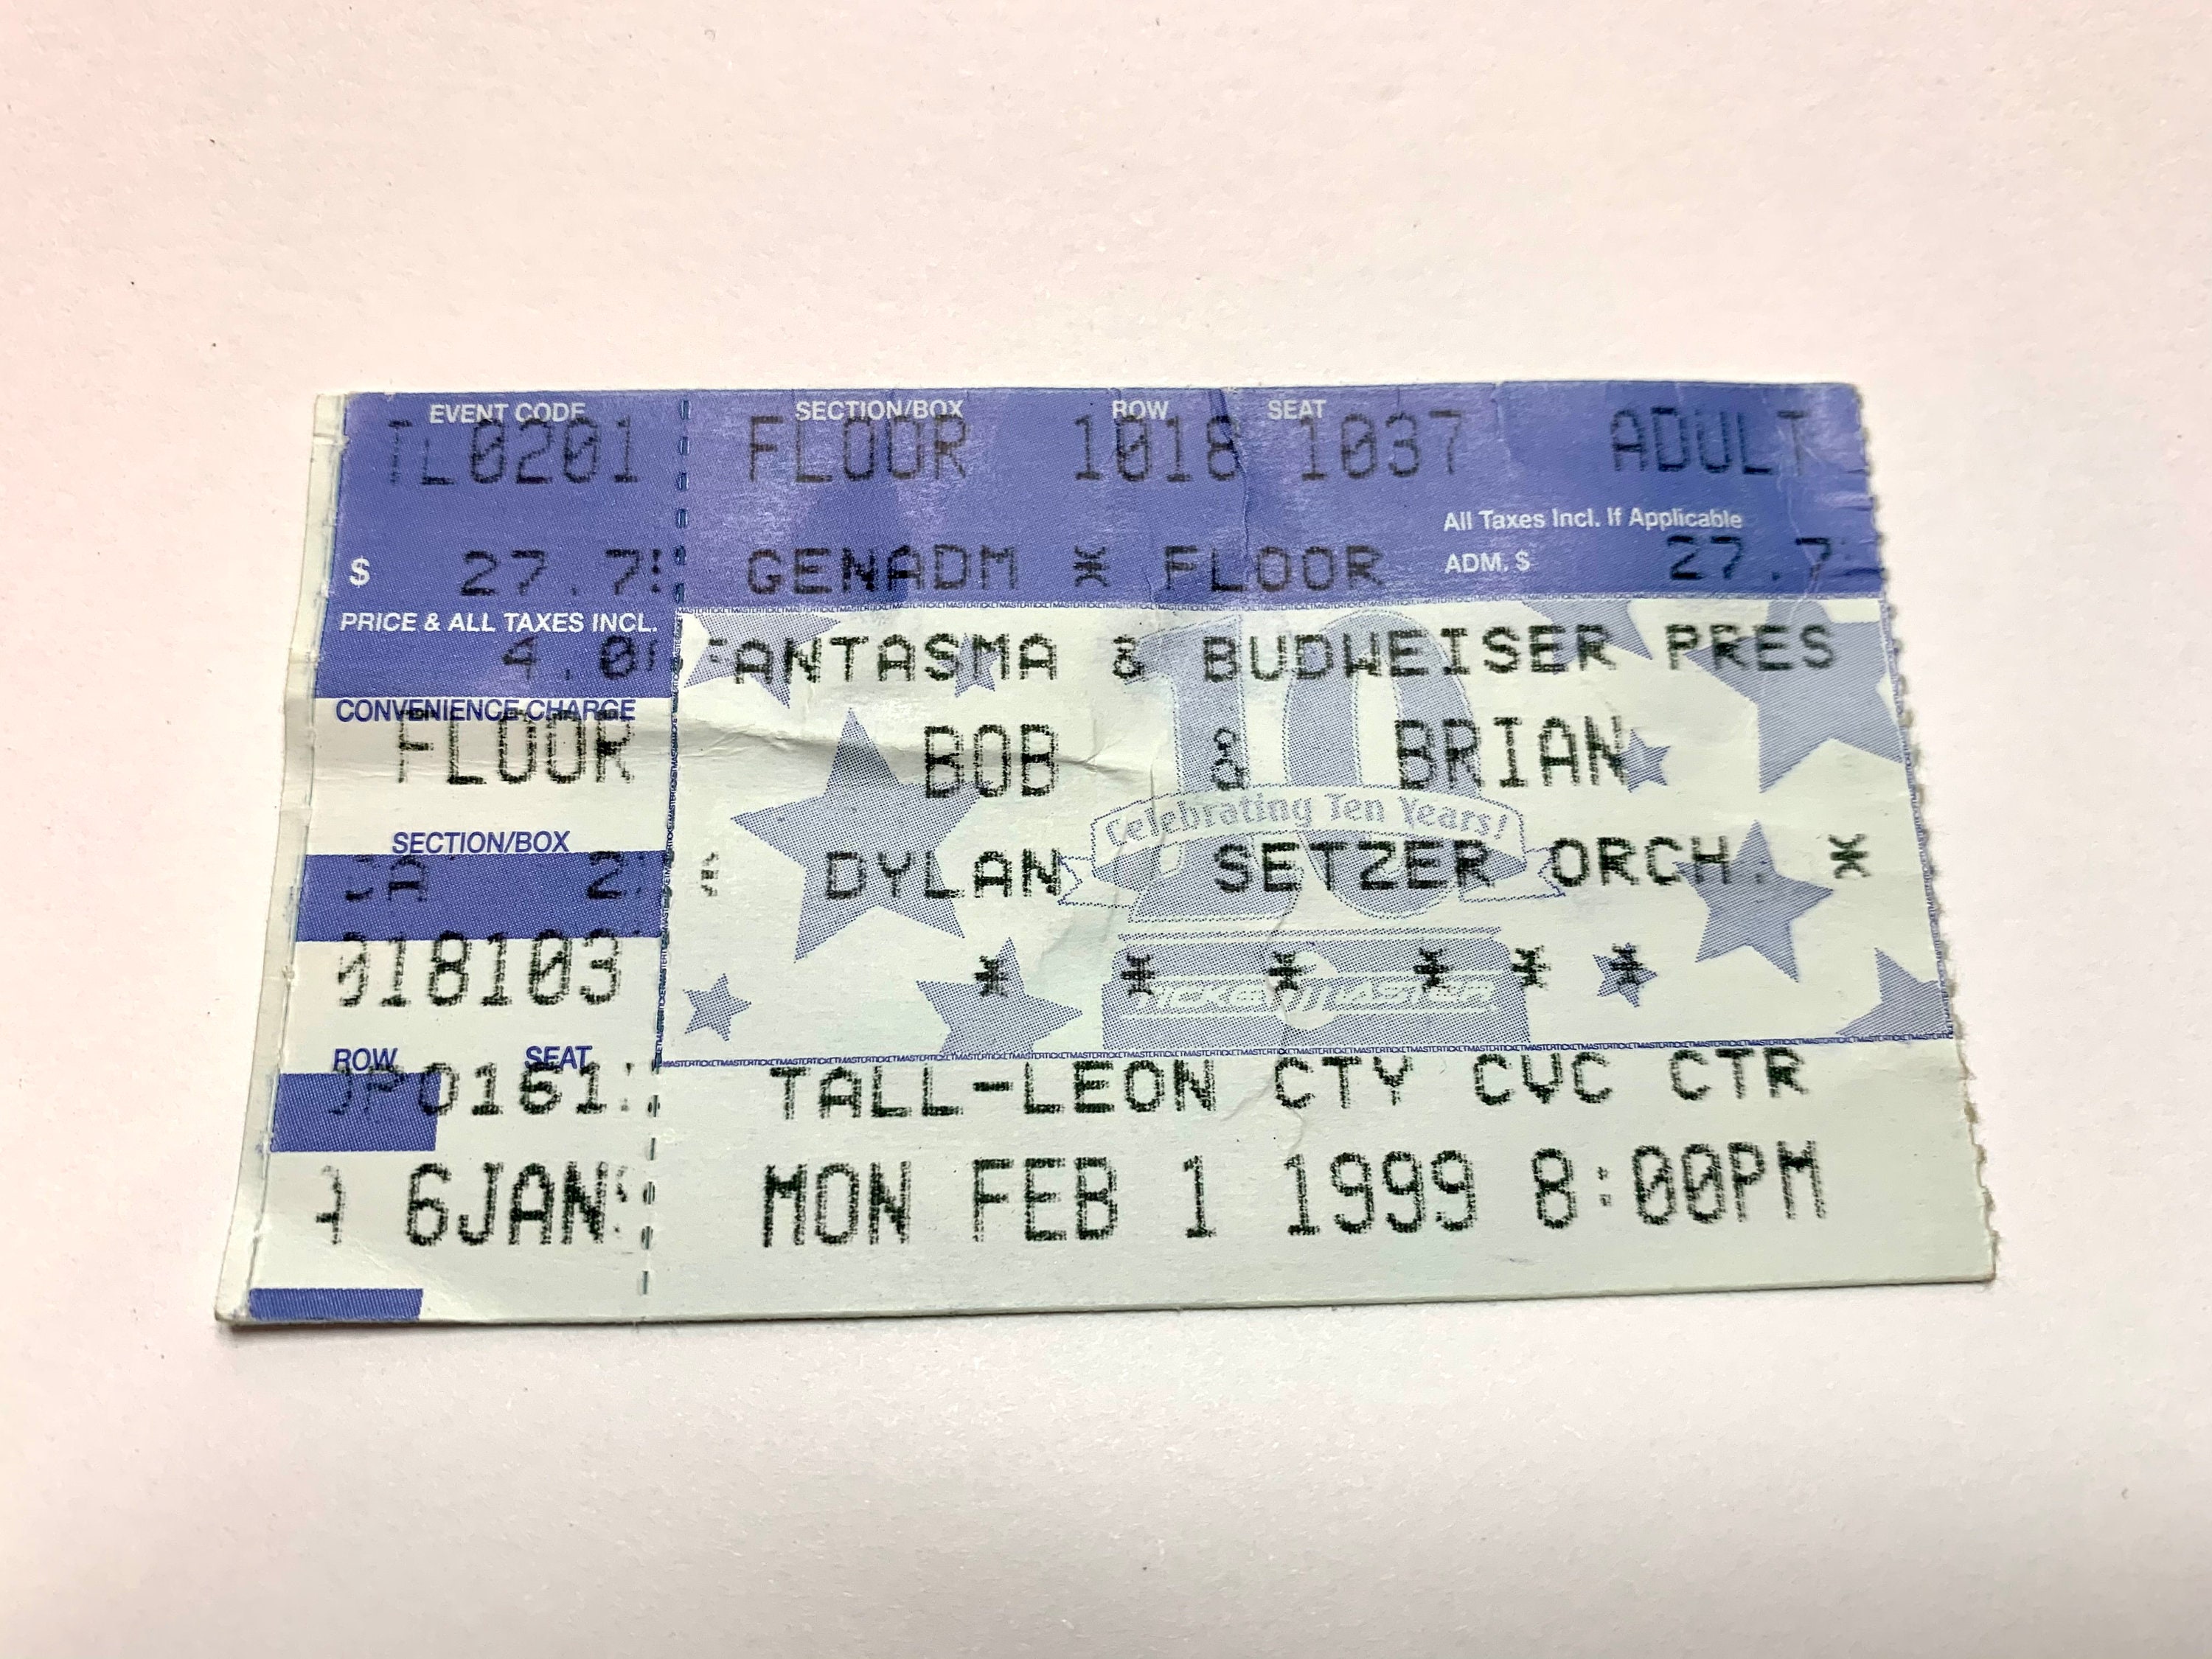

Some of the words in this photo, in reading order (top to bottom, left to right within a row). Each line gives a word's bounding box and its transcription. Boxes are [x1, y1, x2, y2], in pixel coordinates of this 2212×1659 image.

[429, 403, 509, 424] EVENT
[515, 402, 587, 423] CODE
[795, 399, 964, 422] SECTION/BOX
[1112, 400, 1169, 420] ROW
[1268, 399, 1326, 420] SEAT
[387, 416, 641, 485] TL0201
[748, 414, 969, 483] FLOOR
[1074, 414, 1239, 483] 1018
[1300, 409, 1464, 481] 1037
[1610, 406, 1809, 476] ADULT
[1443, 511, 1472, 532] All
[1479, 510, 1545, 530] Taxes
[1553, 509, 1601, 528] Incl.
[1607, 507, 1622, 527] If
[1629, 507, 1743, 532] Applicable
[349, 556, 371, 588] $
[748, 544, 1019, 595] GENADM
[1164, 544, 1384, 593] FLOOR
[1444, 553, 1509, 574] ADM.
[1515, 550, 1531, 572] $
[340, 613, 417, 633] PRICE
[424, 612, 442, 632] &
[448, 612, 495, 633] ALL
[504, 612, 585, 633] TAXES
[592, 611, 658, 633] INCL.
[1113, 633, 1144, 679] &
[1204, 625, 1616, 682] BUDWEISER
[1666, 623, 1836, 672] PRES
[335, 698, 518, 723] CONVENIENCE
[525, 698, 637, 722] CHARGE
[397, 709, 636, 785] FLOOR
[923, 723, 1060, 799] BOB
[1210, 726, 1248, 791] &
[1394, 715, 1628, 791] BRIAN
[1105, 792, 1312, 846] Celebrating
[1324, 792, 1385, 824] Ten
[1400, 795, 1509, 841] Years!
[392, 830, 571, 855] SECTION/BOX
[825, 848, 1062, 900] DYLAN
[1214, 840, 1495, 894] SETZER
[332, 1048, 399, 1074] ROW
[524, 1045, 594, 1071] SEAT
[770, 1058, 1217, 1120] TALL-LEON
[1274, 1054, 1412, 1109] CTY
[1474, 1051, 1613, 1106] CVC
[1669, 1046, 1809, 1102] CTR
[762, 1160, 911, 1248] MON
[971, 1156, 1118, 1243] FEB
[1183, 1154, 1217, 1239] 1
[1283, 1150, 1477, 1235] 1999
[1531, 1140, 1826, 1231] 8:00PM
